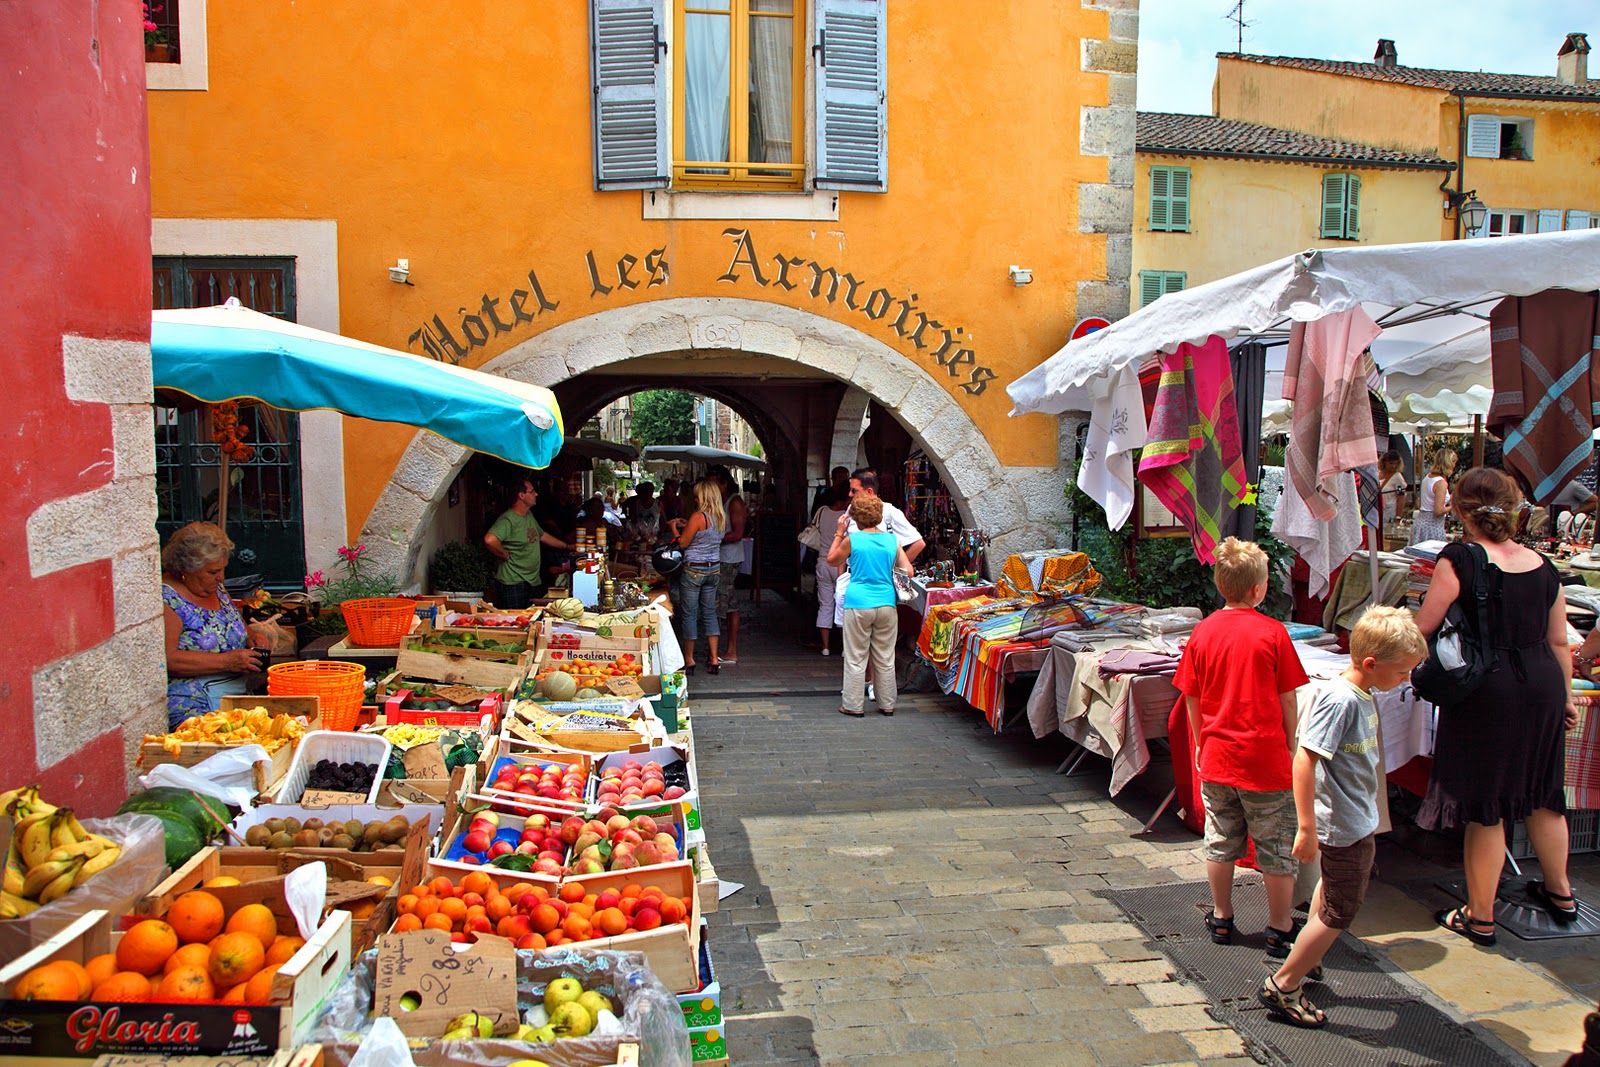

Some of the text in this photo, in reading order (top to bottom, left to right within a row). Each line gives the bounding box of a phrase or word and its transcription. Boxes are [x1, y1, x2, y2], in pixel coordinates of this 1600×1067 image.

[408, 227, 998, 396] Hôtel les Armoiries
[420, 946, 461, 1005] 2.80
[66, 1005, 202, 1051] Gloria
